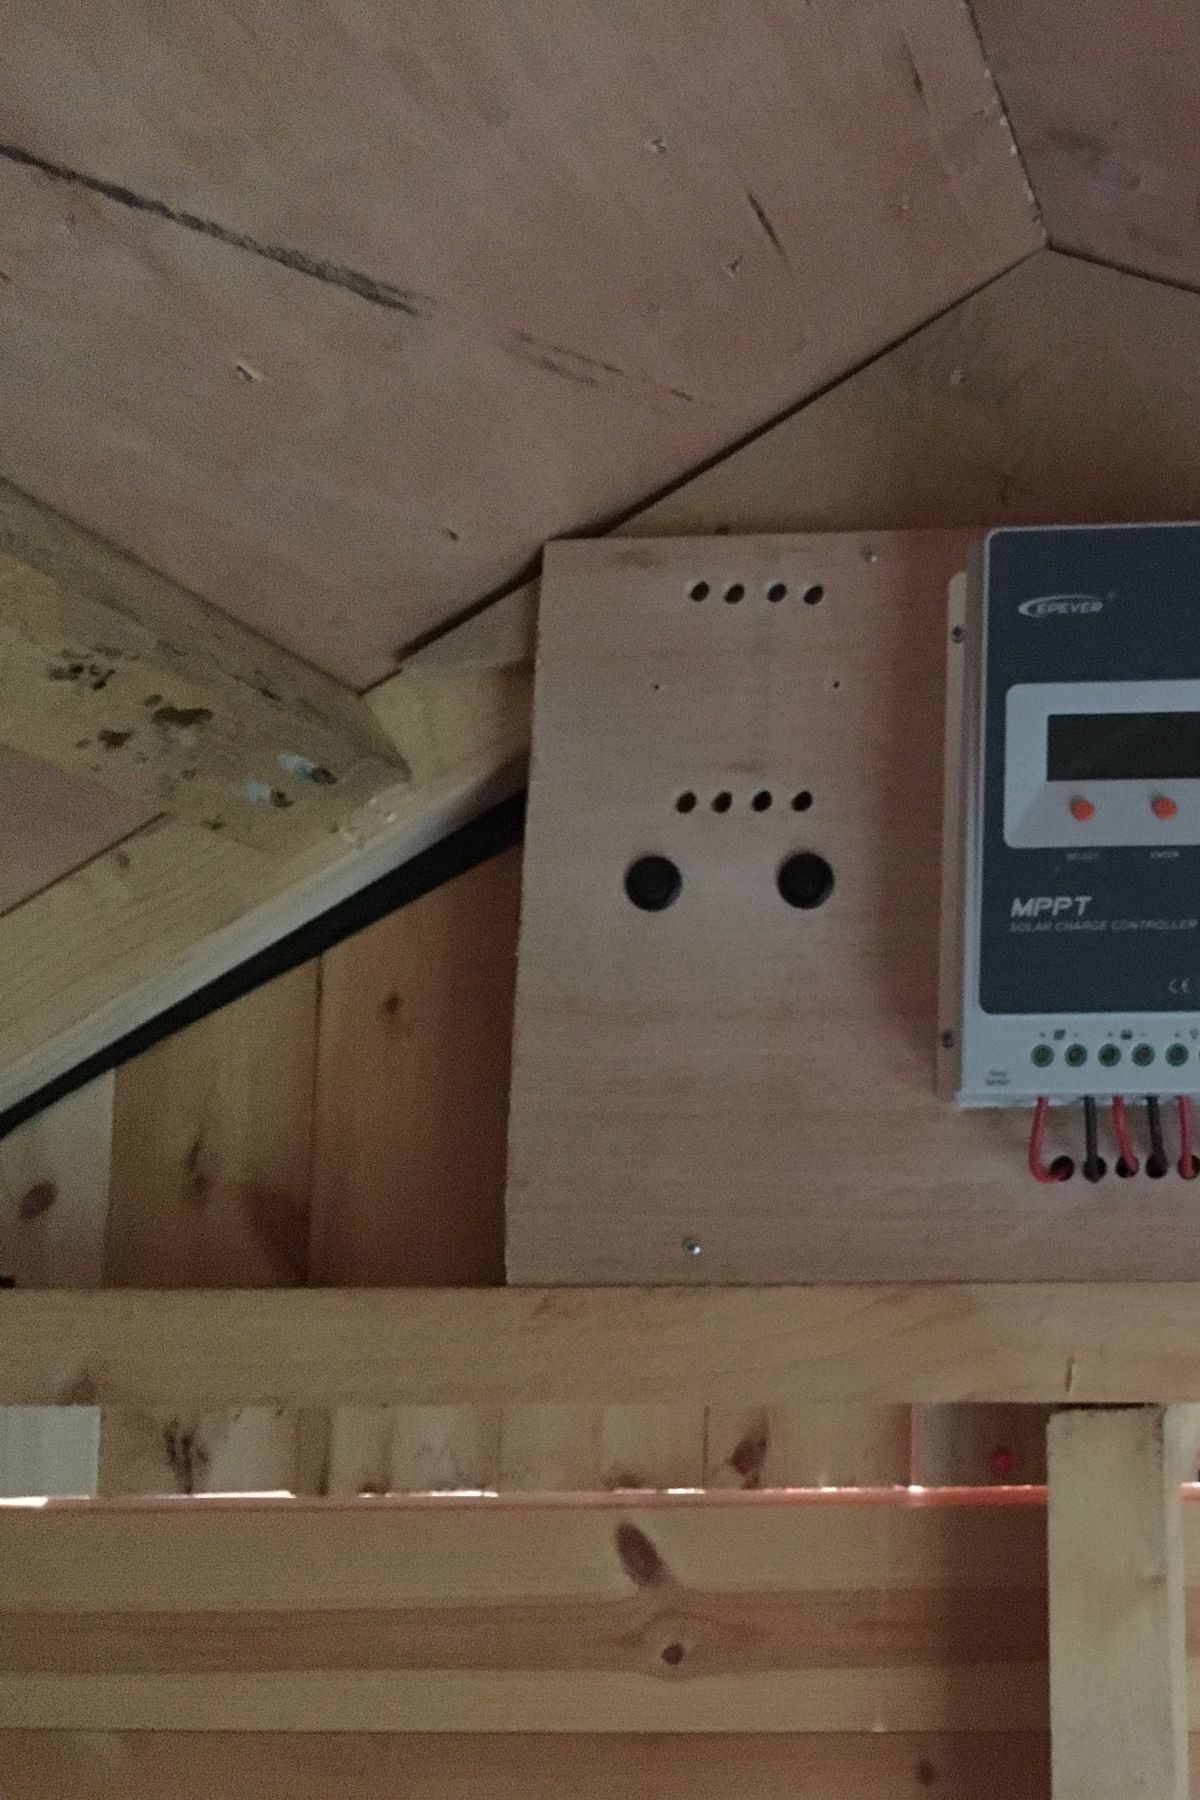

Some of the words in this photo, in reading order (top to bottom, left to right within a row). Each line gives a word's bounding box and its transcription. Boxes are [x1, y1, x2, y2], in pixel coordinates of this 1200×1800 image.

[1010, 895, 1094, 918] MPPT
[1009, 920, 1053, 932] SOLAR
[1054, 919, 1107, 931] CHARGE
[1110, 917, 1199, 930] CONTROLLER
